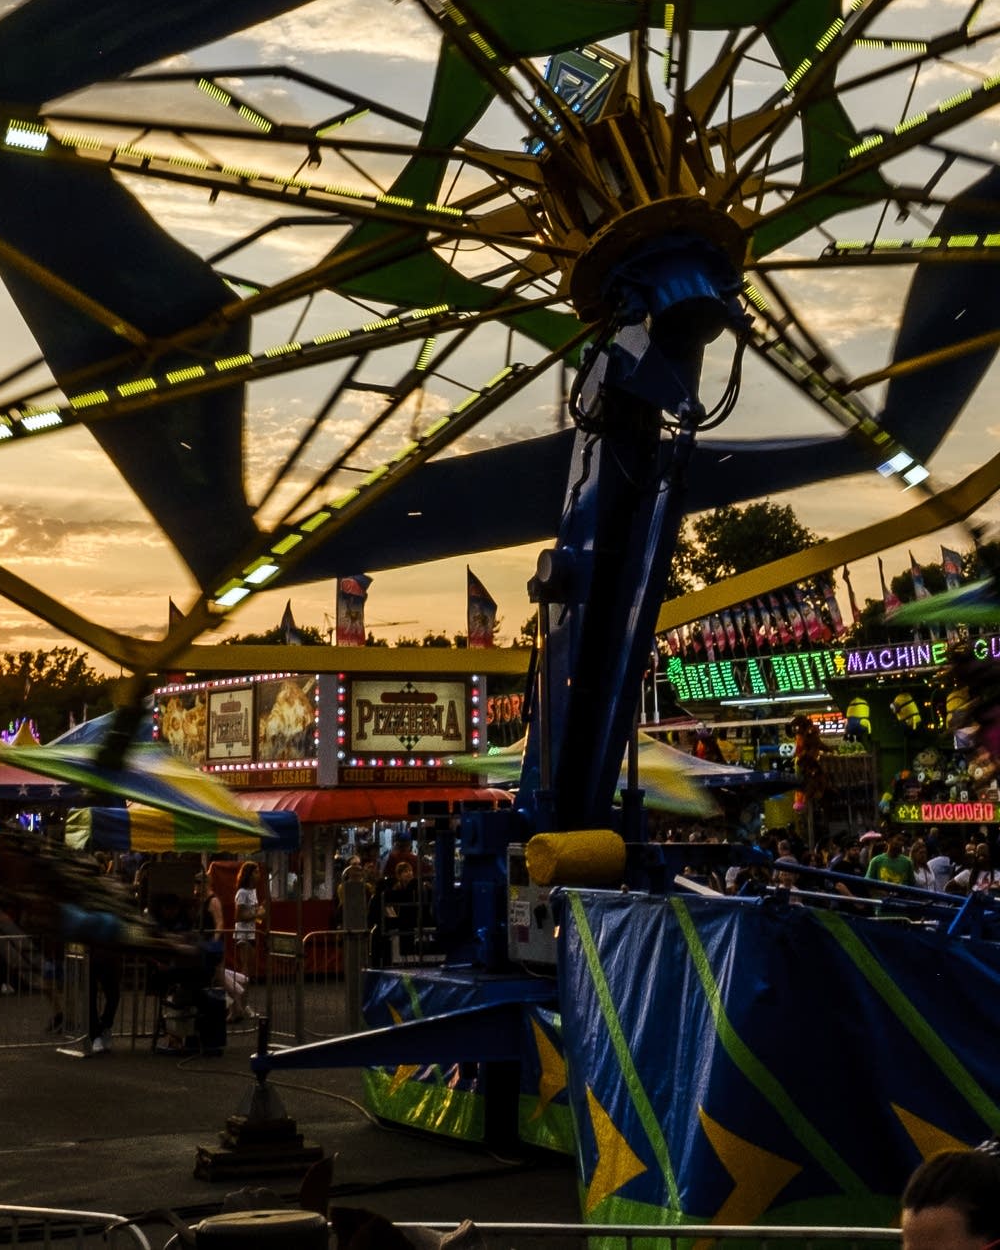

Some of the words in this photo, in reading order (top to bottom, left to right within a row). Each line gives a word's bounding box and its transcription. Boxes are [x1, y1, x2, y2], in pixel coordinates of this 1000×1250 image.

[847, 643, 948, 670] MACHINE
[356, 699, 462, 741] PIZZERIA
[272, 770, 312, 784] SAUSAGE
